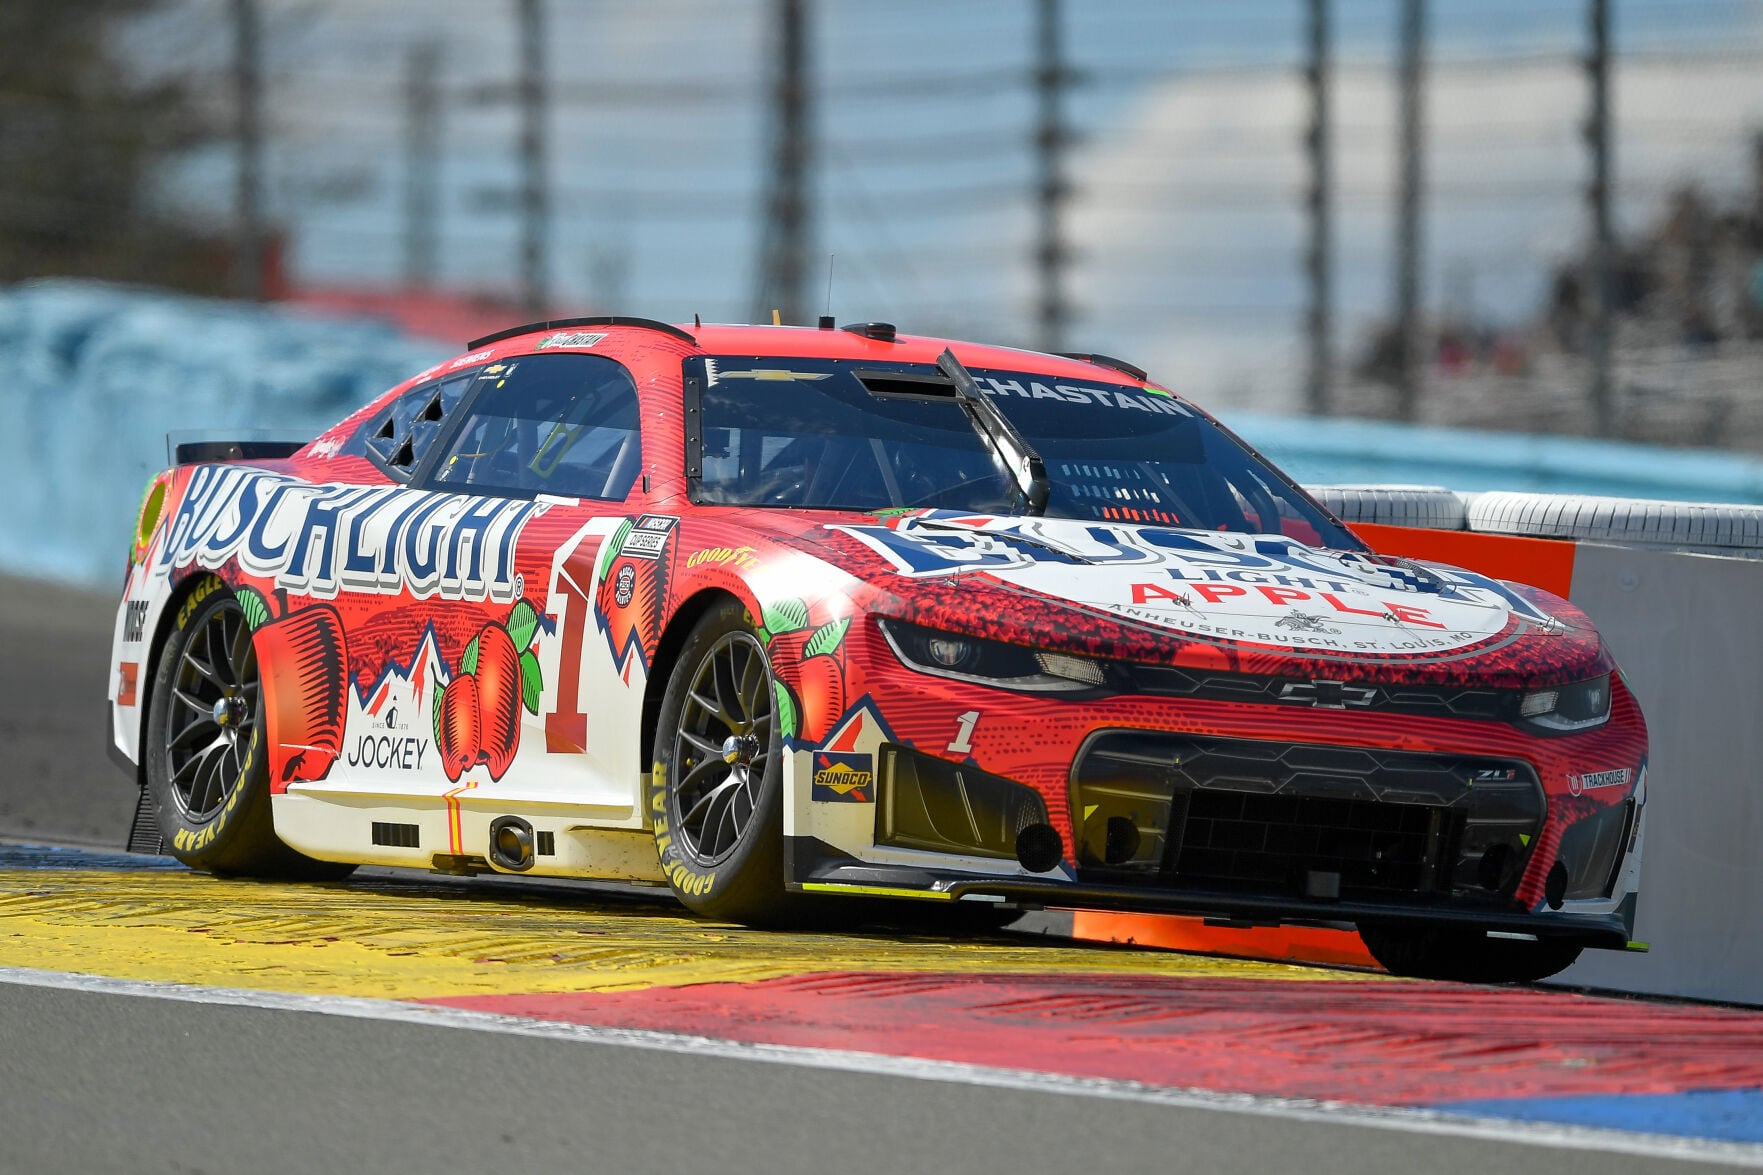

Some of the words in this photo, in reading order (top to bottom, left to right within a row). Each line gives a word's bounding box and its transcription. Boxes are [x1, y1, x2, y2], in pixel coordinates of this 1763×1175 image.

[161, 465, 348, 583] BUSCH
[342, 485, 547, 590] LIGHT
[1166, 568, 1350, 593] LIGHT
[177, 575, 222, 632] EAGLE
[1131, 583, 1448, 629] APPLE
[545, 518, 612, 754] 1
[1109, 603, 1347, 649] ANHEUSER-BUSCH,
[1353, 640, 1385, 650] ST.
[1453, 631, 1473, 643] MO
[348, 735, 428, 770] JOCKEY
[947, 711, 979, 753] 1
[816, 771, 869, 786] SUNOCO
[1584, 773, 1626, 788] TRACKHOUSE
